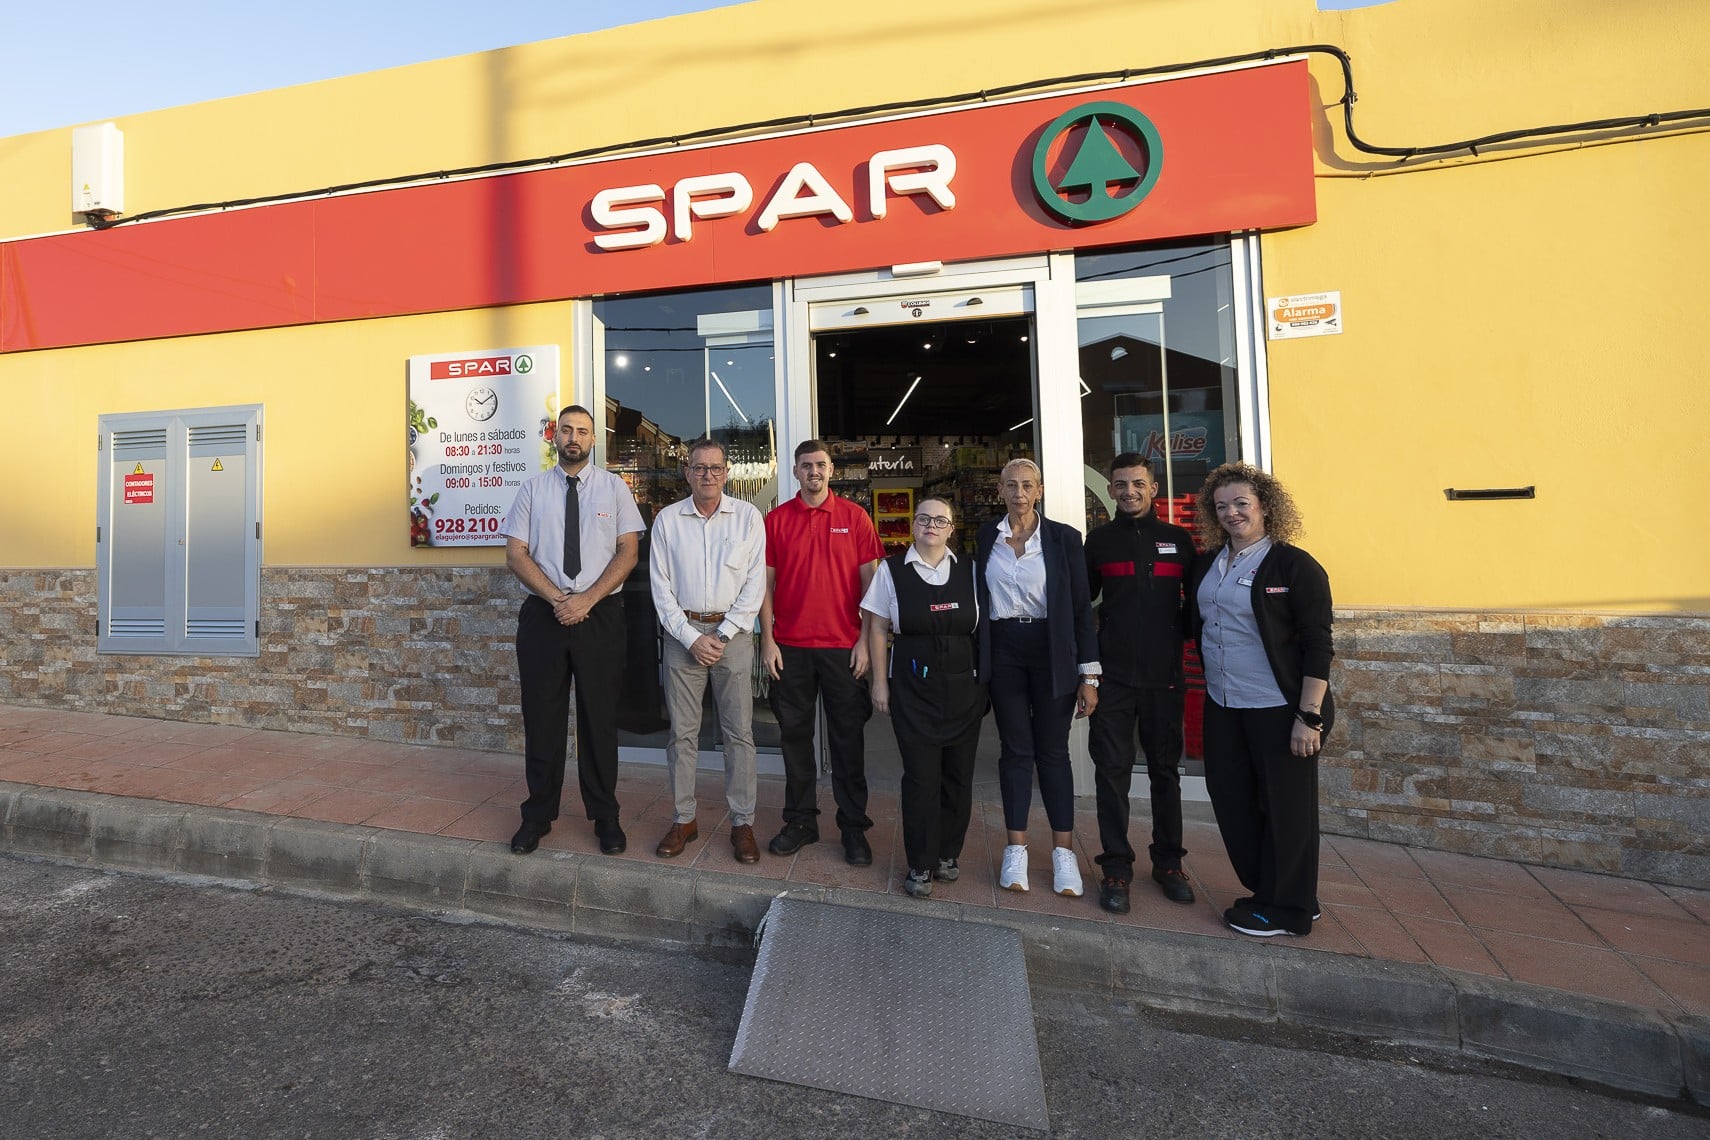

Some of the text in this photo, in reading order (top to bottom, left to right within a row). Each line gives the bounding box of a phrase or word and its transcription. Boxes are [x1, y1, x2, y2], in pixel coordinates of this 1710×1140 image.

[590, 144, 957, 251] SPAR
[1283, 307, 1326, 318] Alarma
[448, 359, 510, 376] SPAR
[440, 428, 526, 443] De lunes a sábados
[445, 445, 470, 457] 08:30
[477, 443, 503, 456] 21:30
[504, 446, 520, 455] horas
[440, 460, 526, 476] Domingos y festivos
[445, 477, 470, 489] 09:00
[478, 476, 503, 488] 15:00
[504, 479, 520, 487] horas
[464, 503, 502, 515] Pedidos:
[435, 516, 499, 533] 928 210
